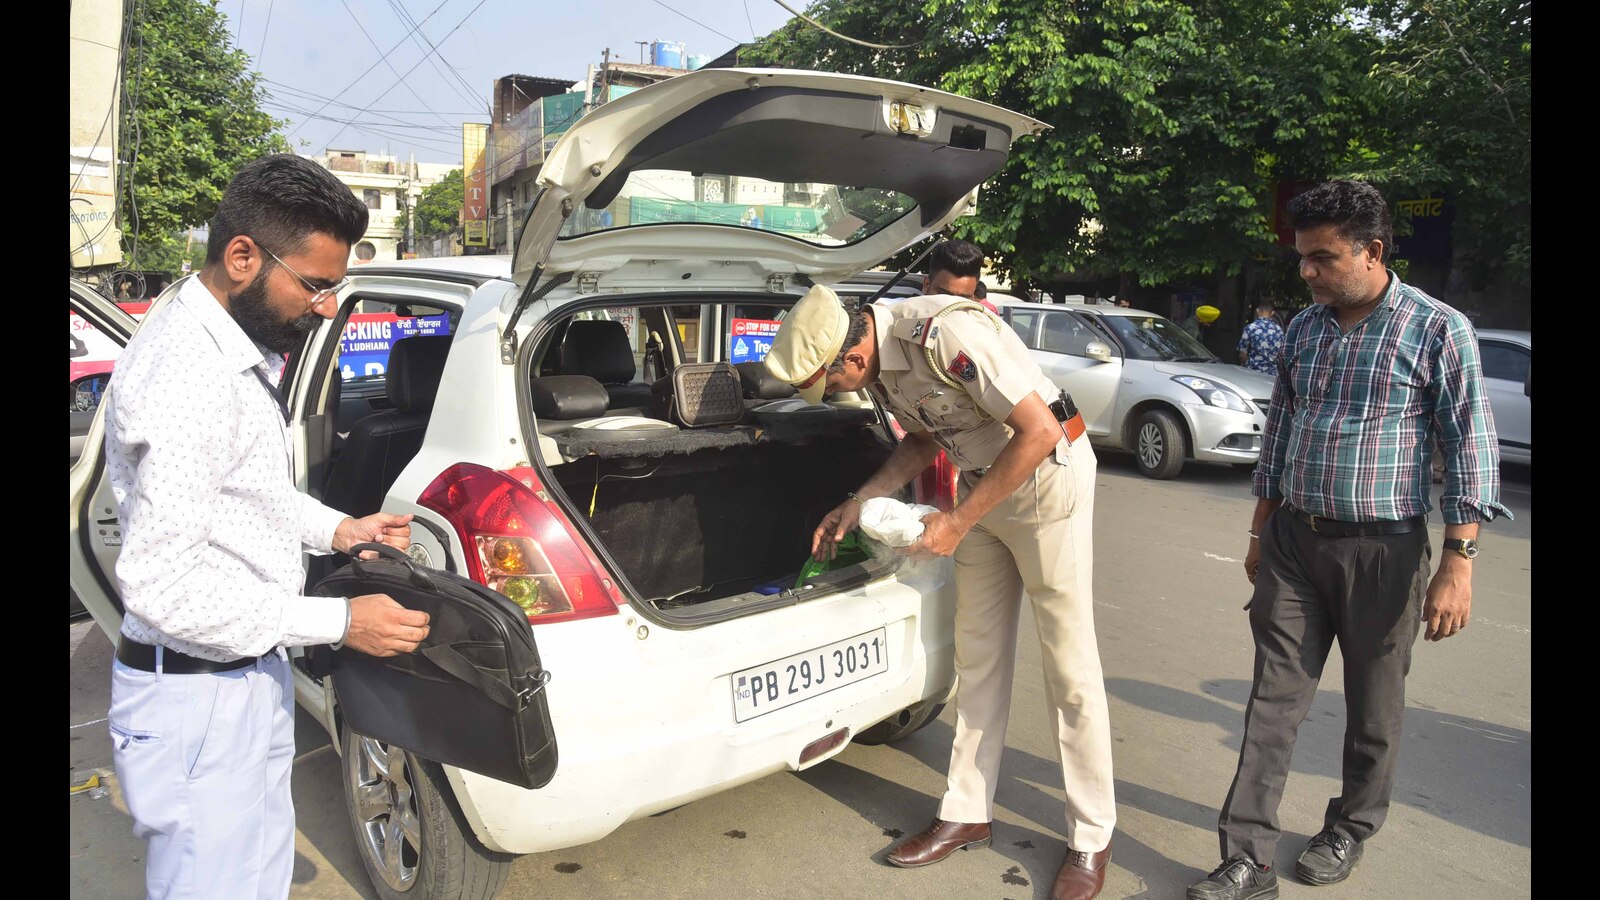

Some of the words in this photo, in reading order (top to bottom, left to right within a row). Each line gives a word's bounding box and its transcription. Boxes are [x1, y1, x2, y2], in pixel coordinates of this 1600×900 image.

[746, 322, 759, 330] STOP
[759, 323, 770, 331] FOR
[350, 341, 389, 352] LUDHIANA
[750, 670, 779, 708] PB
[786, 654, 826, 695] 29J
[832, 637, 881, 678] 3031
[737, 689, 751, 701] IND
